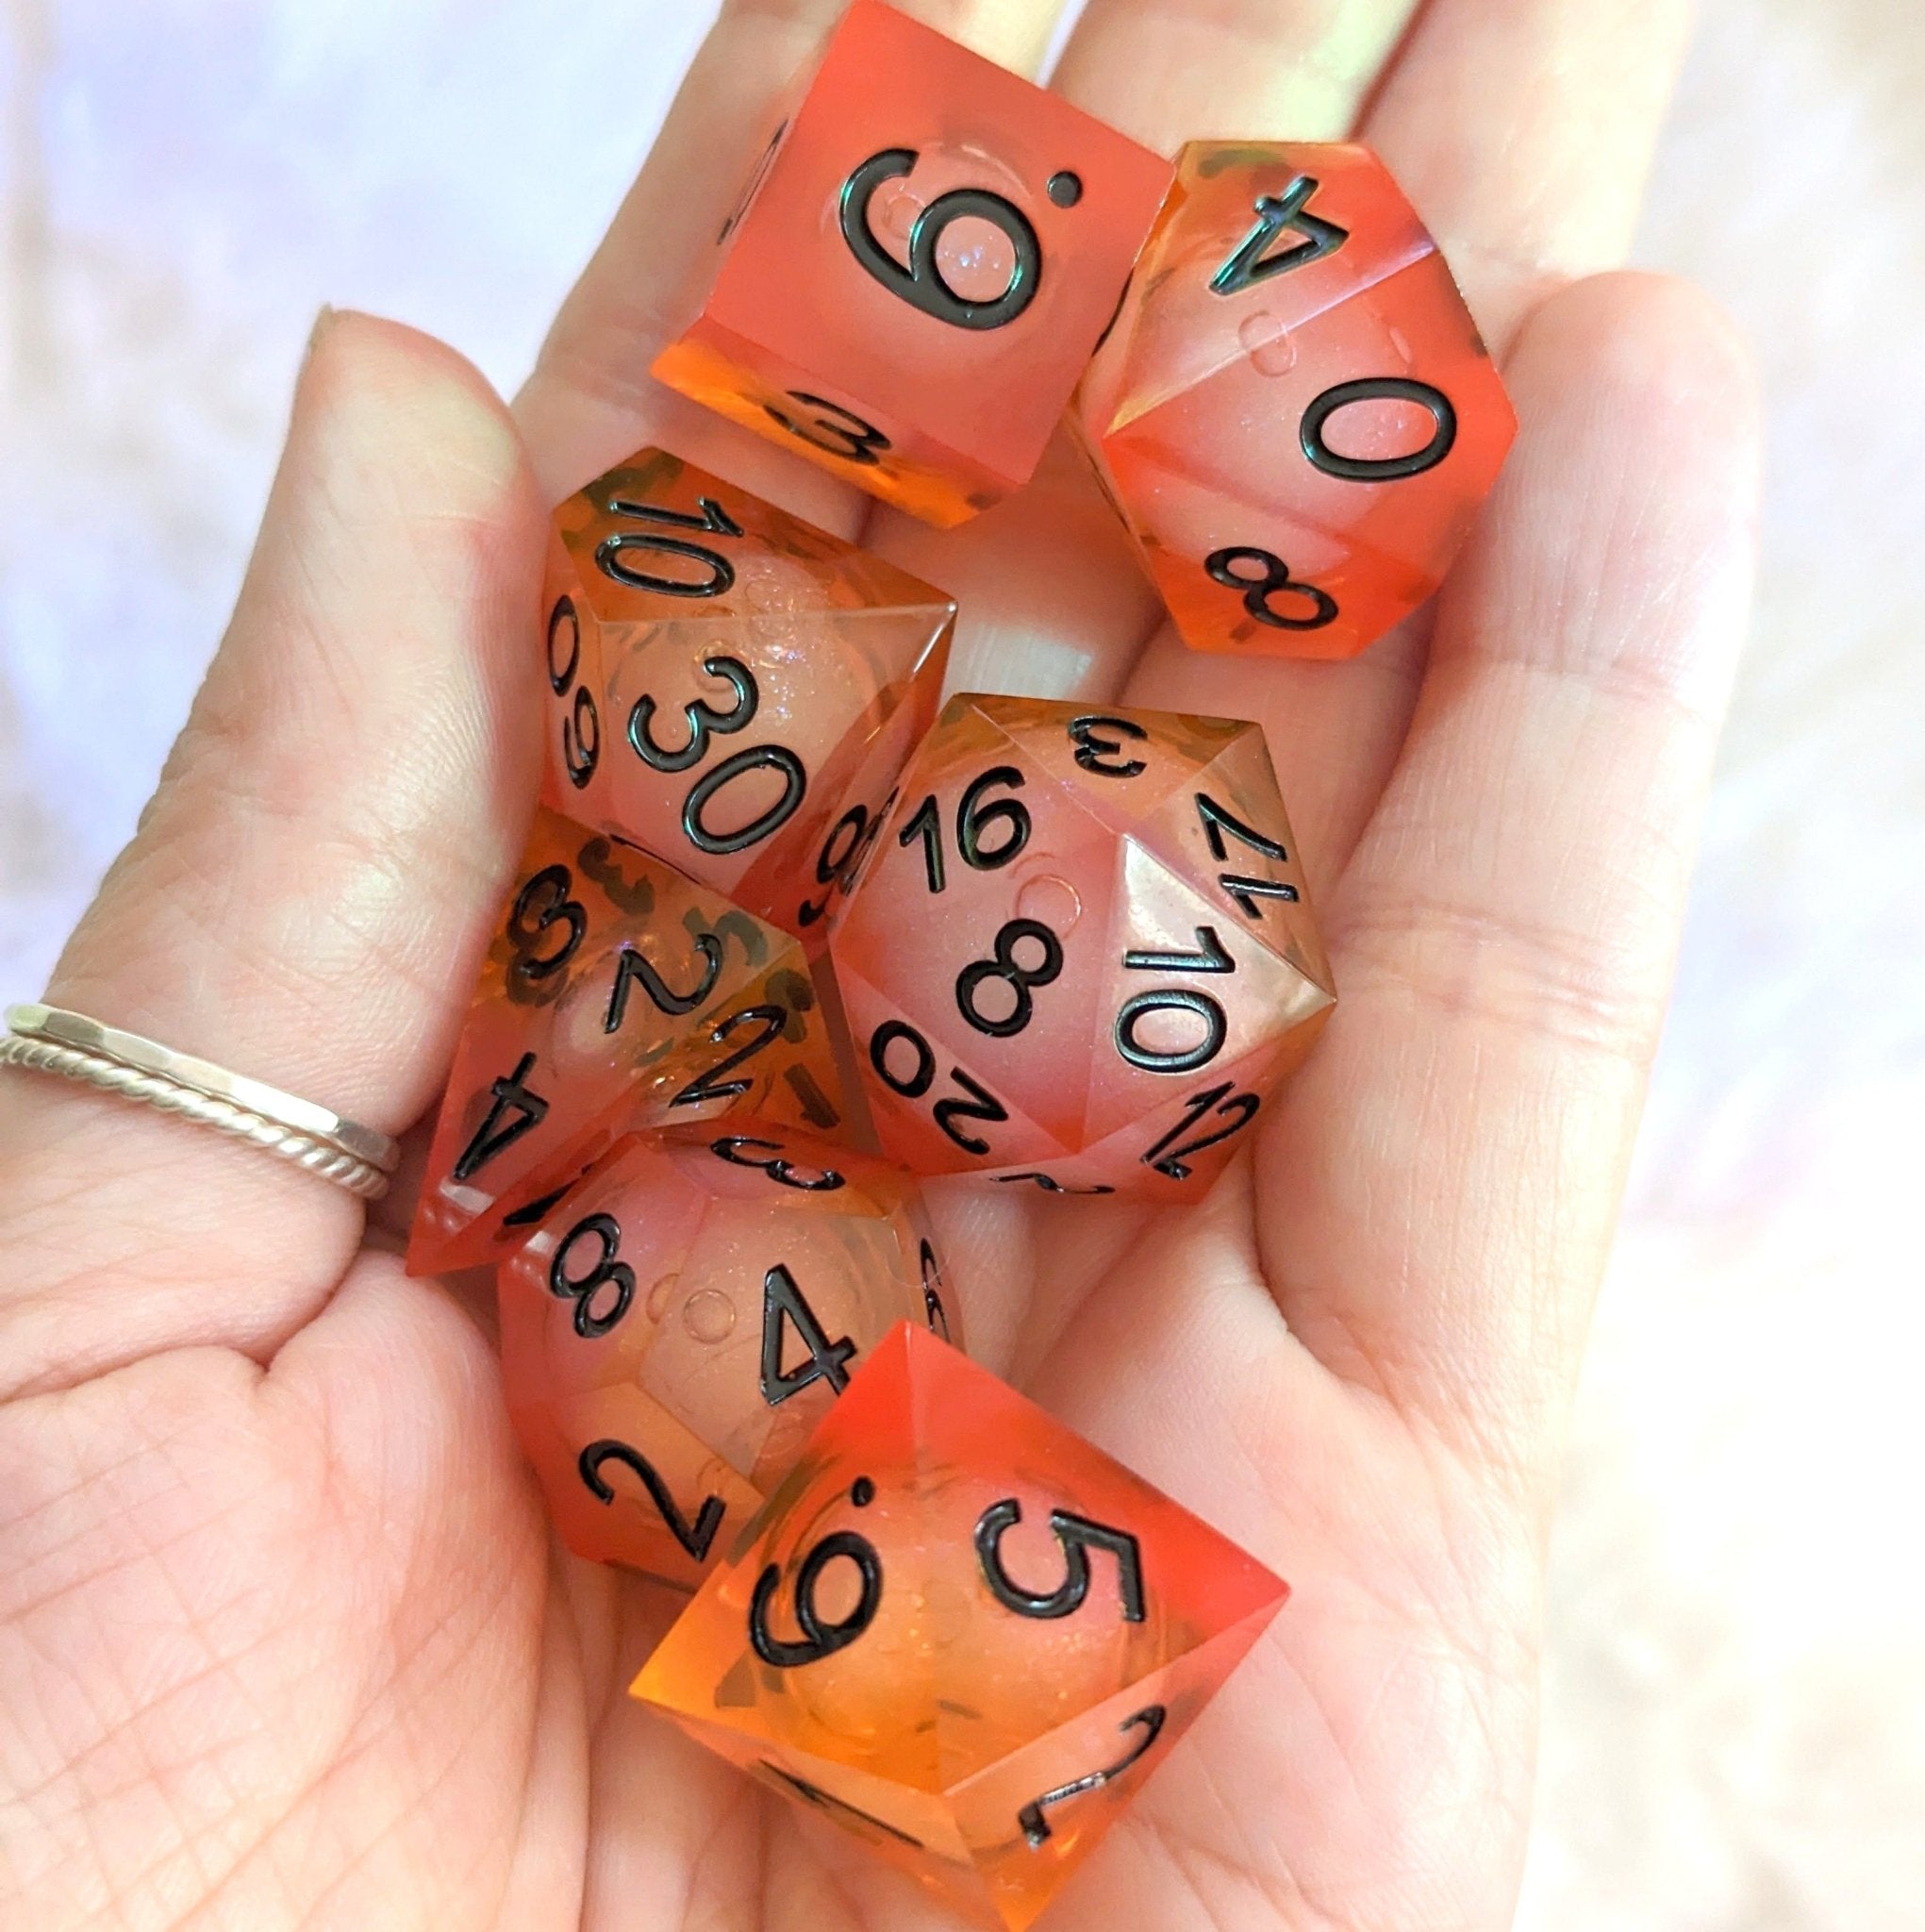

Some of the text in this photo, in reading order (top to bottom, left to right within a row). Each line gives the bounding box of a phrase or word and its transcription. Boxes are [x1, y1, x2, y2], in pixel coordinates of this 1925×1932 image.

[1208, 175, 1349, 295] 4
[764, 390, 892, 467] 3
[1300, 377, 1456, 483] 0
[595, 496, 744, 598] 10
[1204, 546, 1339, 631] 8
[628, 657, 806, 855] 30
[1068, 715, 1148, 778] 3
[899, 766, 1032, 893] 16
[1194, 791, 1300, 919] 17
[604, 933, 722, 1034] 2
[956, 918, 1064, 1037] 8
[1114, 925, 1236, 1073] 10
[453, 1051, 549, 1181] 4
[669, 1004, 788, 1108] 2
[871, 1019, 1008, 1155] 20
[710, 1136, 846, 1191] 3
[1139, 1081, 1260, 1181] 12
[549, 1212, 636, 1339] 8
[760, 1263, 857, 1407] 4
[578, 1440, 726, 1562] 2
[975, 1497, 1146, 1623] 5
[1019, 1704, 1166, 1850] 2
